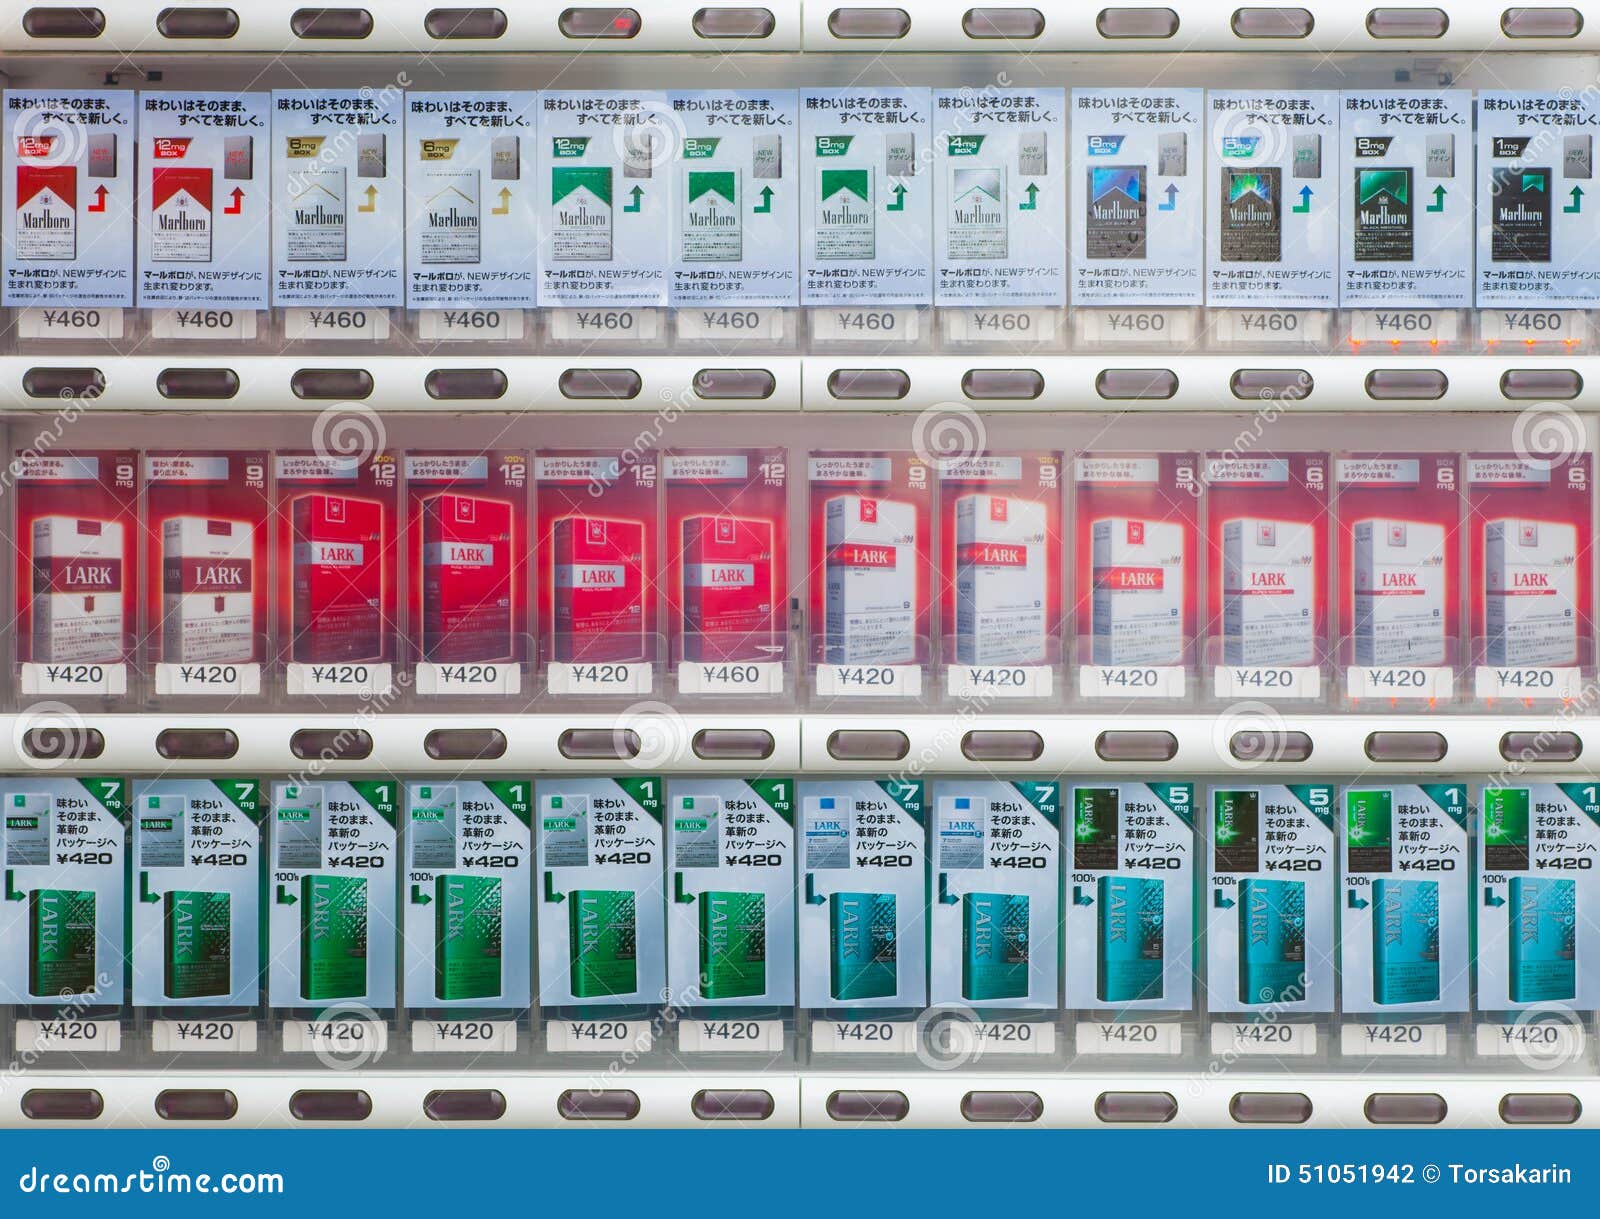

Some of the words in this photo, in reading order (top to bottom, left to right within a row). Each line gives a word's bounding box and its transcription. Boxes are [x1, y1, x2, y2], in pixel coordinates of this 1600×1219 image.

[23, 209, 70, 229] Marlboro
[159, 211, 205, 230] Marlboro
[295, 205, 344, 225] Marlboro
[429, 208, 477, 227] Marlboro
[560, 207, 605, 226] Marlboro
[689, 208, 735, 227] Marlboro
[822, 205, 868, 224] Marlboro
[955, 205, 1001, 224] Marlboro
[1361, 206, 1407, 225] Marlboro
[43, 311, 99, 327] ¥460
[177, 311, 233, 328] ¥460
[310, 312, 366, 328] ¥460
[444, 312, 500, 328] ¥460
[577, 313, 633, 329] ¥460
[704, 312, 759, 328] ¥460
[839, 314, 895, 330] ¥460
[974, 314, 1030, 330] ¥460
[1109, 314, 1164, 331] ¥460
[1242, 315, 1297, 331] ¥460
[1376, 314, 1432, 330] ¥460
[1505, 314, 1561, 330] ¥460
[116, 465, 133, 478] 9
[500, 464, 525, 478] 12
[760, 464, 785, 478] 12
[909, 467, 926, 480] 9
[1307, 468, 1323, 481] 6
[1437, 468, 1454, 481] 6
[505, 479, 522, 487] mg
[321, 548, 354, 561] LARK
[451, 548, 484, 561] LARK
[854, 550, 887, 563] LARK
[984, 549, 1018, 562] LARK
[66, 566, 112, 584] LARK
[196, 567, 242, 585] LARK
[582, 570, 615, 583] LARK
[711, 569, 745, 582] LARK
[1121, 572, 1155, 586] LARK
[1252, 573, 1285, 586] LARK
[1383, 573, 1416, 586] LARK
[1514, 573, 1548, 586] LARK
[47, 667, 103, 682] ¥420
[181, 667, 236, 683] ¥420
[312, 667, 367, 682] ¥420
[442, 666, 496, 682] ¥420
[573, 666, 628, 682] ¥420
[704, 666, 759, 682] ¥460
[839, 669, 894, 685] ¥420
[1102, 670, 1157, 686] ¥420
[1236, 671, 1292, 687] ¥420
[1370, 670, 1426, 686] ¥420
[1498, 671, 1553, 687] ¥420
[101, 782, 120, 798] 7
[375, 786, 388, 801] 1
[509, 786, 522, 801] 1
[1035, 787, 1054, 802] 7
[1169, 787, 1188, 803] 5
[1445, 788, 1458, 804] 1
[191, 800, 223, 809] 味わい
[378, 803, 392, 811] mg
[463, 802, 494, 811] 味わい
[512, 803, 526, 811] mg
[856, 802, 887, 811] 味わい
[1398, 805, 1430, 814] 味わい
[1448, 806, 1462, 814] mg
[191, 813, 236, 822] そのまま、
[463, 815, 507, 824] そのまま、
[856, 815, 901, 824] そのまま、
[1398, 818, 1443, 828] そのまま、
[191, 827, 223, 836] 革新の
[463, 828, 494, 837] 革新の
[815, 822, 840, 830] LARK
[856, 828, 887, 837] 革新の
[949, 822, 975, 830] LARK
[191, 840, 251, 848] パッケージへ
[1399, 832, 1430, 840] 革新の
[463, 842, 523, 850] パッケージへ
[856, 841, 916, 850] パッケージへ
[1399, 845, 1460, 853] パッケージへ
[191, 854, 247, 865] ¥420
[463, 856, 518, 868] ¥420
[595, 852, 651, 864] ¥420
[856, 856, 912, 867] ¥420
[1125, 858, 1180, 869] ¥420
[1399, 860, 1455, 871] ¥420
[313, 883, 329, 939] LARK
[448, 883, 464, 940] LARK
[1110, 885, 1127, 942] LARK
[1251, 887, 1268, 945] LARK
[1385, 887, 1402, 945] LARK
[1521, 885, 1539, 944] LARK
[42, 898, 58, 952] LARK
[177, 900, 192, 954] LARK
[581, 899, 598, 954] LARK
[712, 900, 728, 956] LARK
[843, 901, 859, 958] LARK
[976, 901, 992, 958] LARK
[178, 1024, 233, 1040] ¥420
[437, 1023, 493, 1039] ¥420
[572, 1023, 627, 1039] ¥420
[704, 1023, 759, 1039] ¥420
[837, 1024, 893, 1040] ¥420
[1102, 1025, 1157, 1041] ¥420
[1366, 1026, 1422, 1042] ¥420
